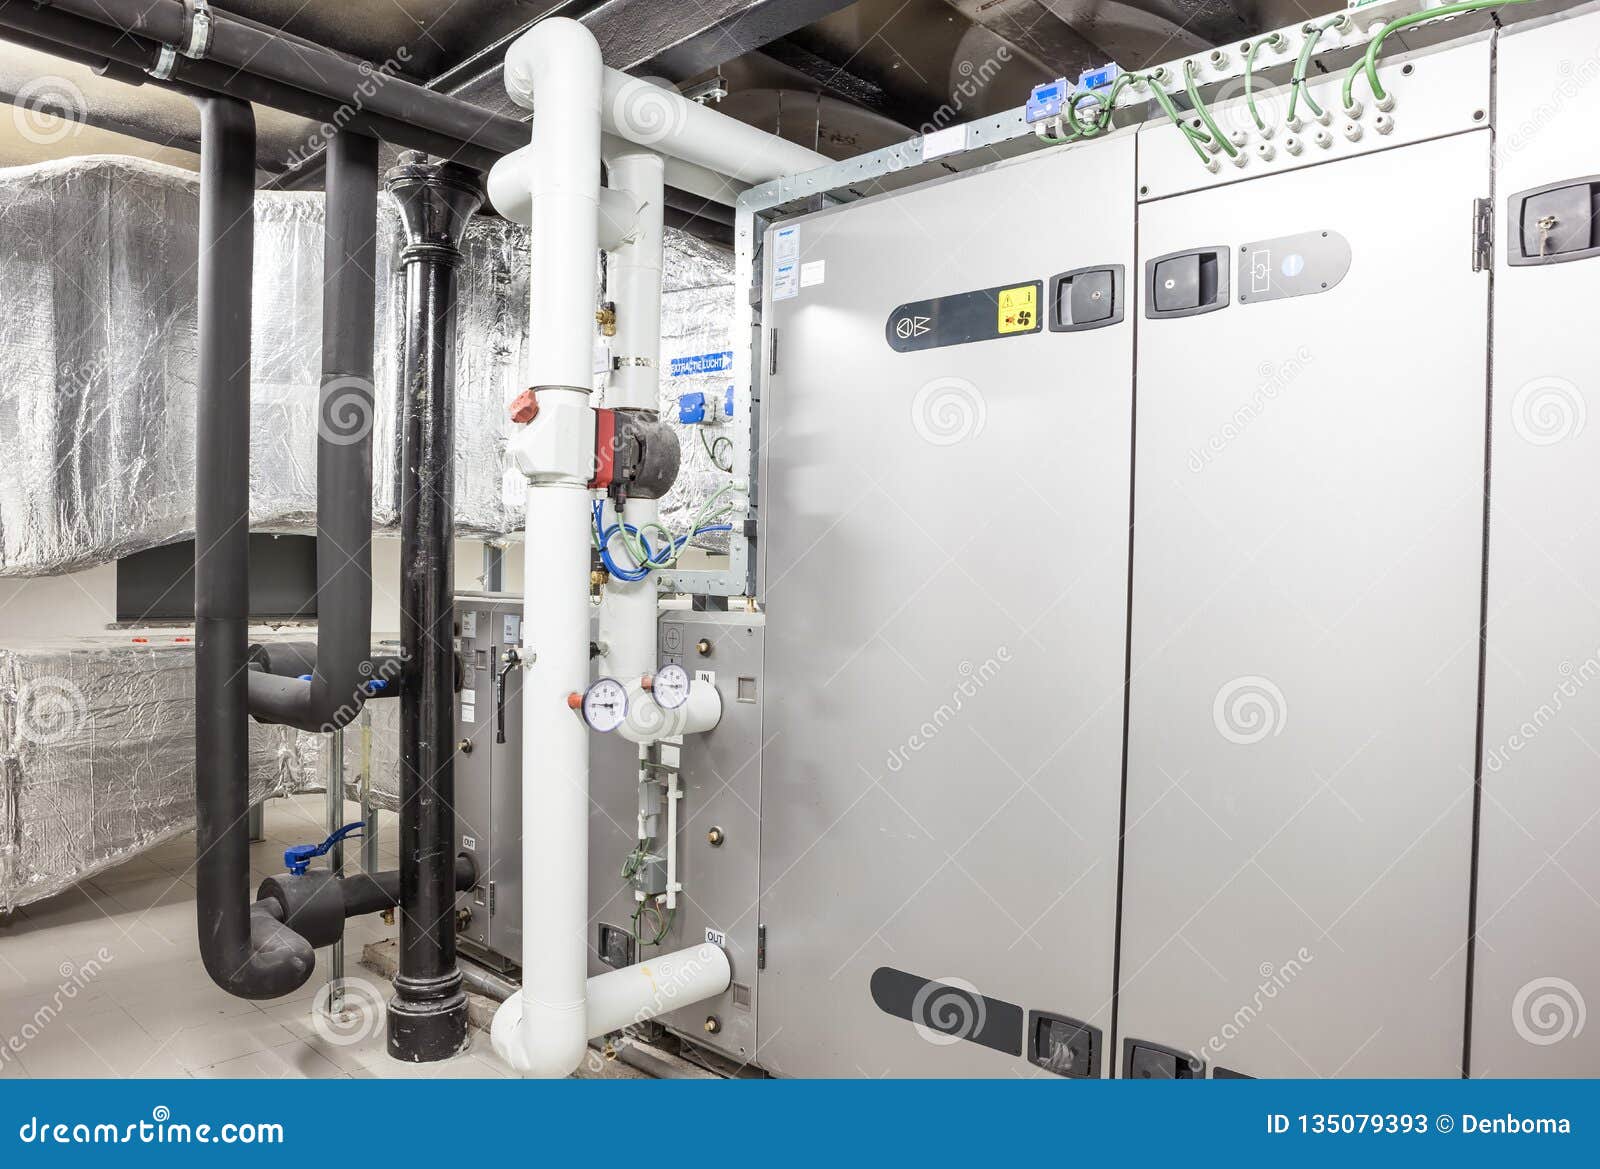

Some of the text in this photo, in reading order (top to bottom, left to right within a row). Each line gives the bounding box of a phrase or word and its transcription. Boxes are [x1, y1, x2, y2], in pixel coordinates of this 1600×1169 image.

[703, 358, 722, 369] LUCHT
[701, 673, 710, 683] IN
[464, 838, 474, 847] OUT
[707, 931, 723, 944] OUT
